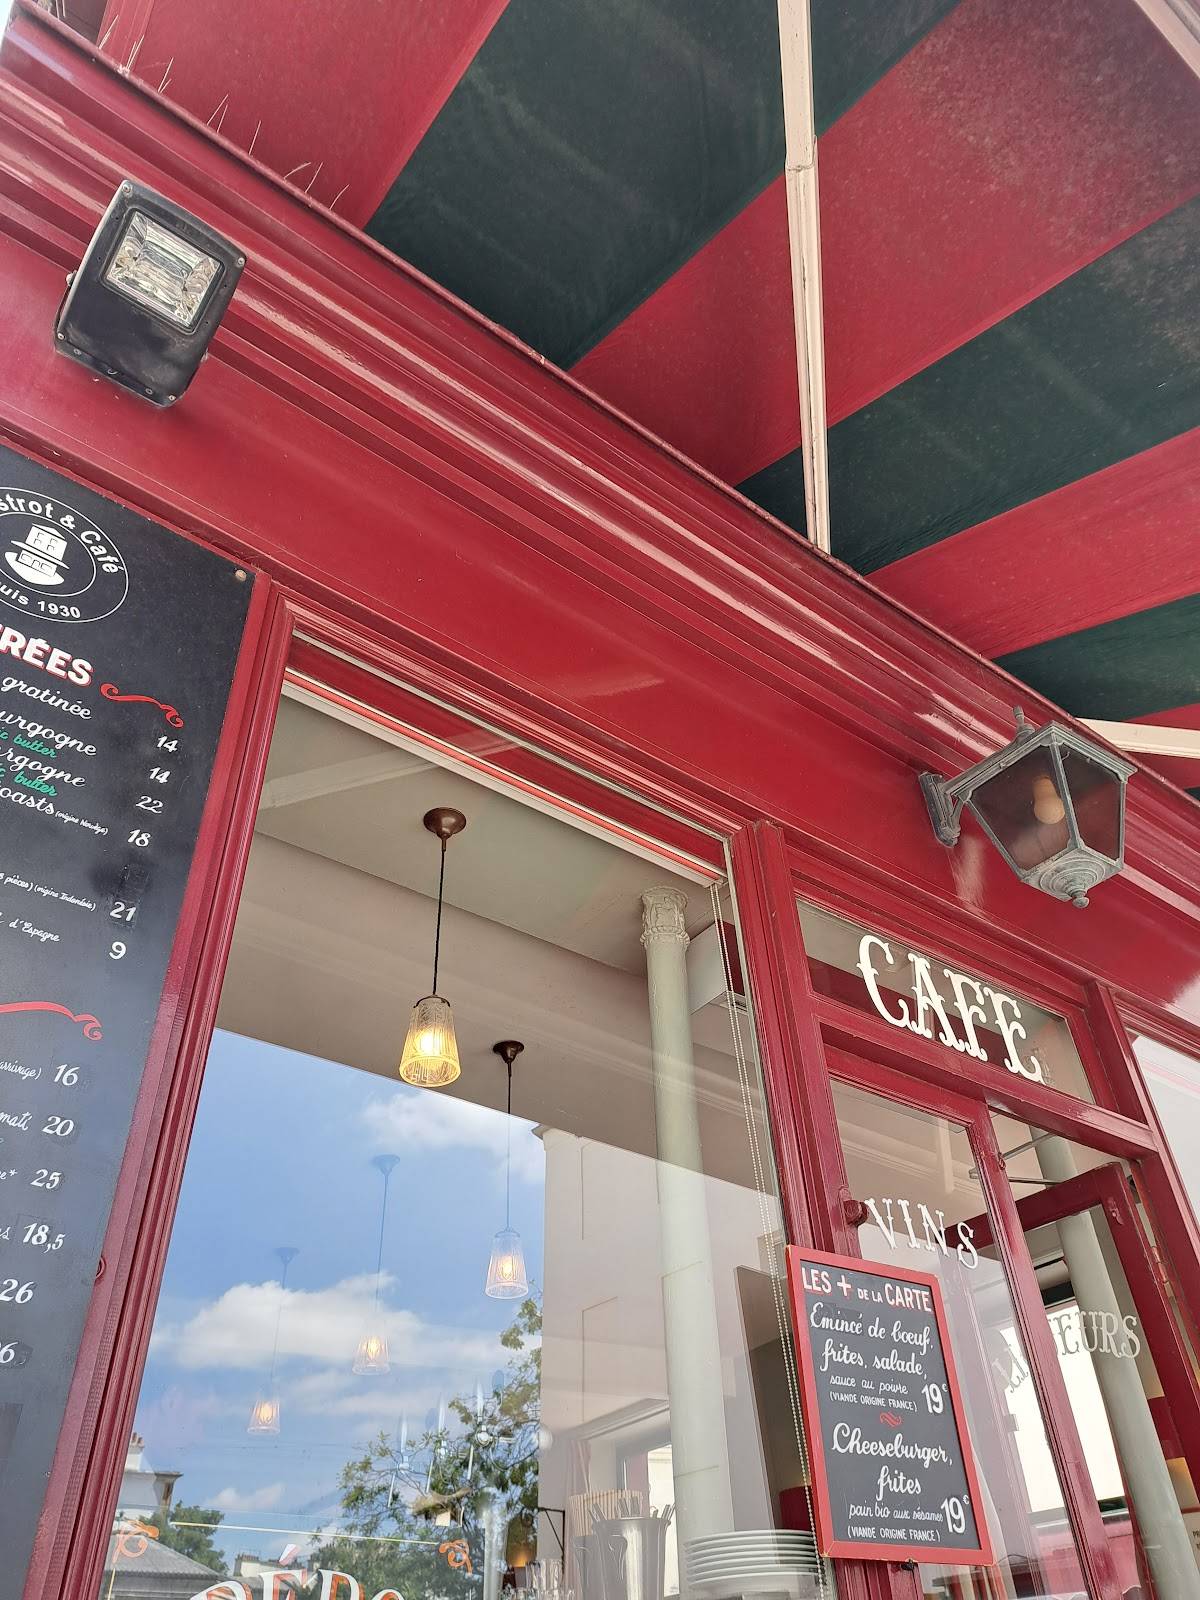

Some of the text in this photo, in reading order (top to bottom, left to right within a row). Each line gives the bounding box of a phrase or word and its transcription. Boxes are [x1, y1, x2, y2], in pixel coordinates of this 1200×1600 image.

[60, 515, 76, 529] &
[81, 531, 125, 573] Café
[0, 580, 81, 618] uis 1930
[0, 624, 94, 686] RÉES
[1, 676, 178, 753] gratinée 14
[13, 733, 57, 758] butter
[0, 746, 163, 814] rgogne 22
[14, 770, 58, 797] butter
[149, 766, 171, 784] 14
[0, 782, 55, 815] oasts
[127, 829, 151, 847] 18
[109, 901, 137, 922] 21
[109, 941, 127, 959] 9
[53, 1063, 81, 1086] 16
[41, 1115, 75, 1137] 20
[30, 1168, 63, 1190] 25
[22, 1222, 66, 1254] 18,5
[864, 1198, 979, 1270] VINS
[0, 1278, 35, 1304] 26
[801, 1266, 832, 1294] LES
[857, 1287, 871, 1301] DE
[872, 1290, 884, 1304] LA
[884, 1283, 932, 1313] CARTE
[868, 1317, 886, 1339] de
[872, 1350, 928, 1379] salade,
[829, 1375, 856, 1388] sauce
[861, 1379, 875, 1390] au
[879, 1378, 909, 1395] poivre
[829, 1391, 918, 1413] (VIANDE ORIGINE FRANCE)
[832, 1422, 953, 1469] Cheeseburger,
[876, 1465, 922, 1502] frites
[848, 1500, 873, 1520] pain
[874, 1502, 890, 1519] bio
[847, 1525, 941, 1543] (VIANDE ORIGINE FRANCE)
